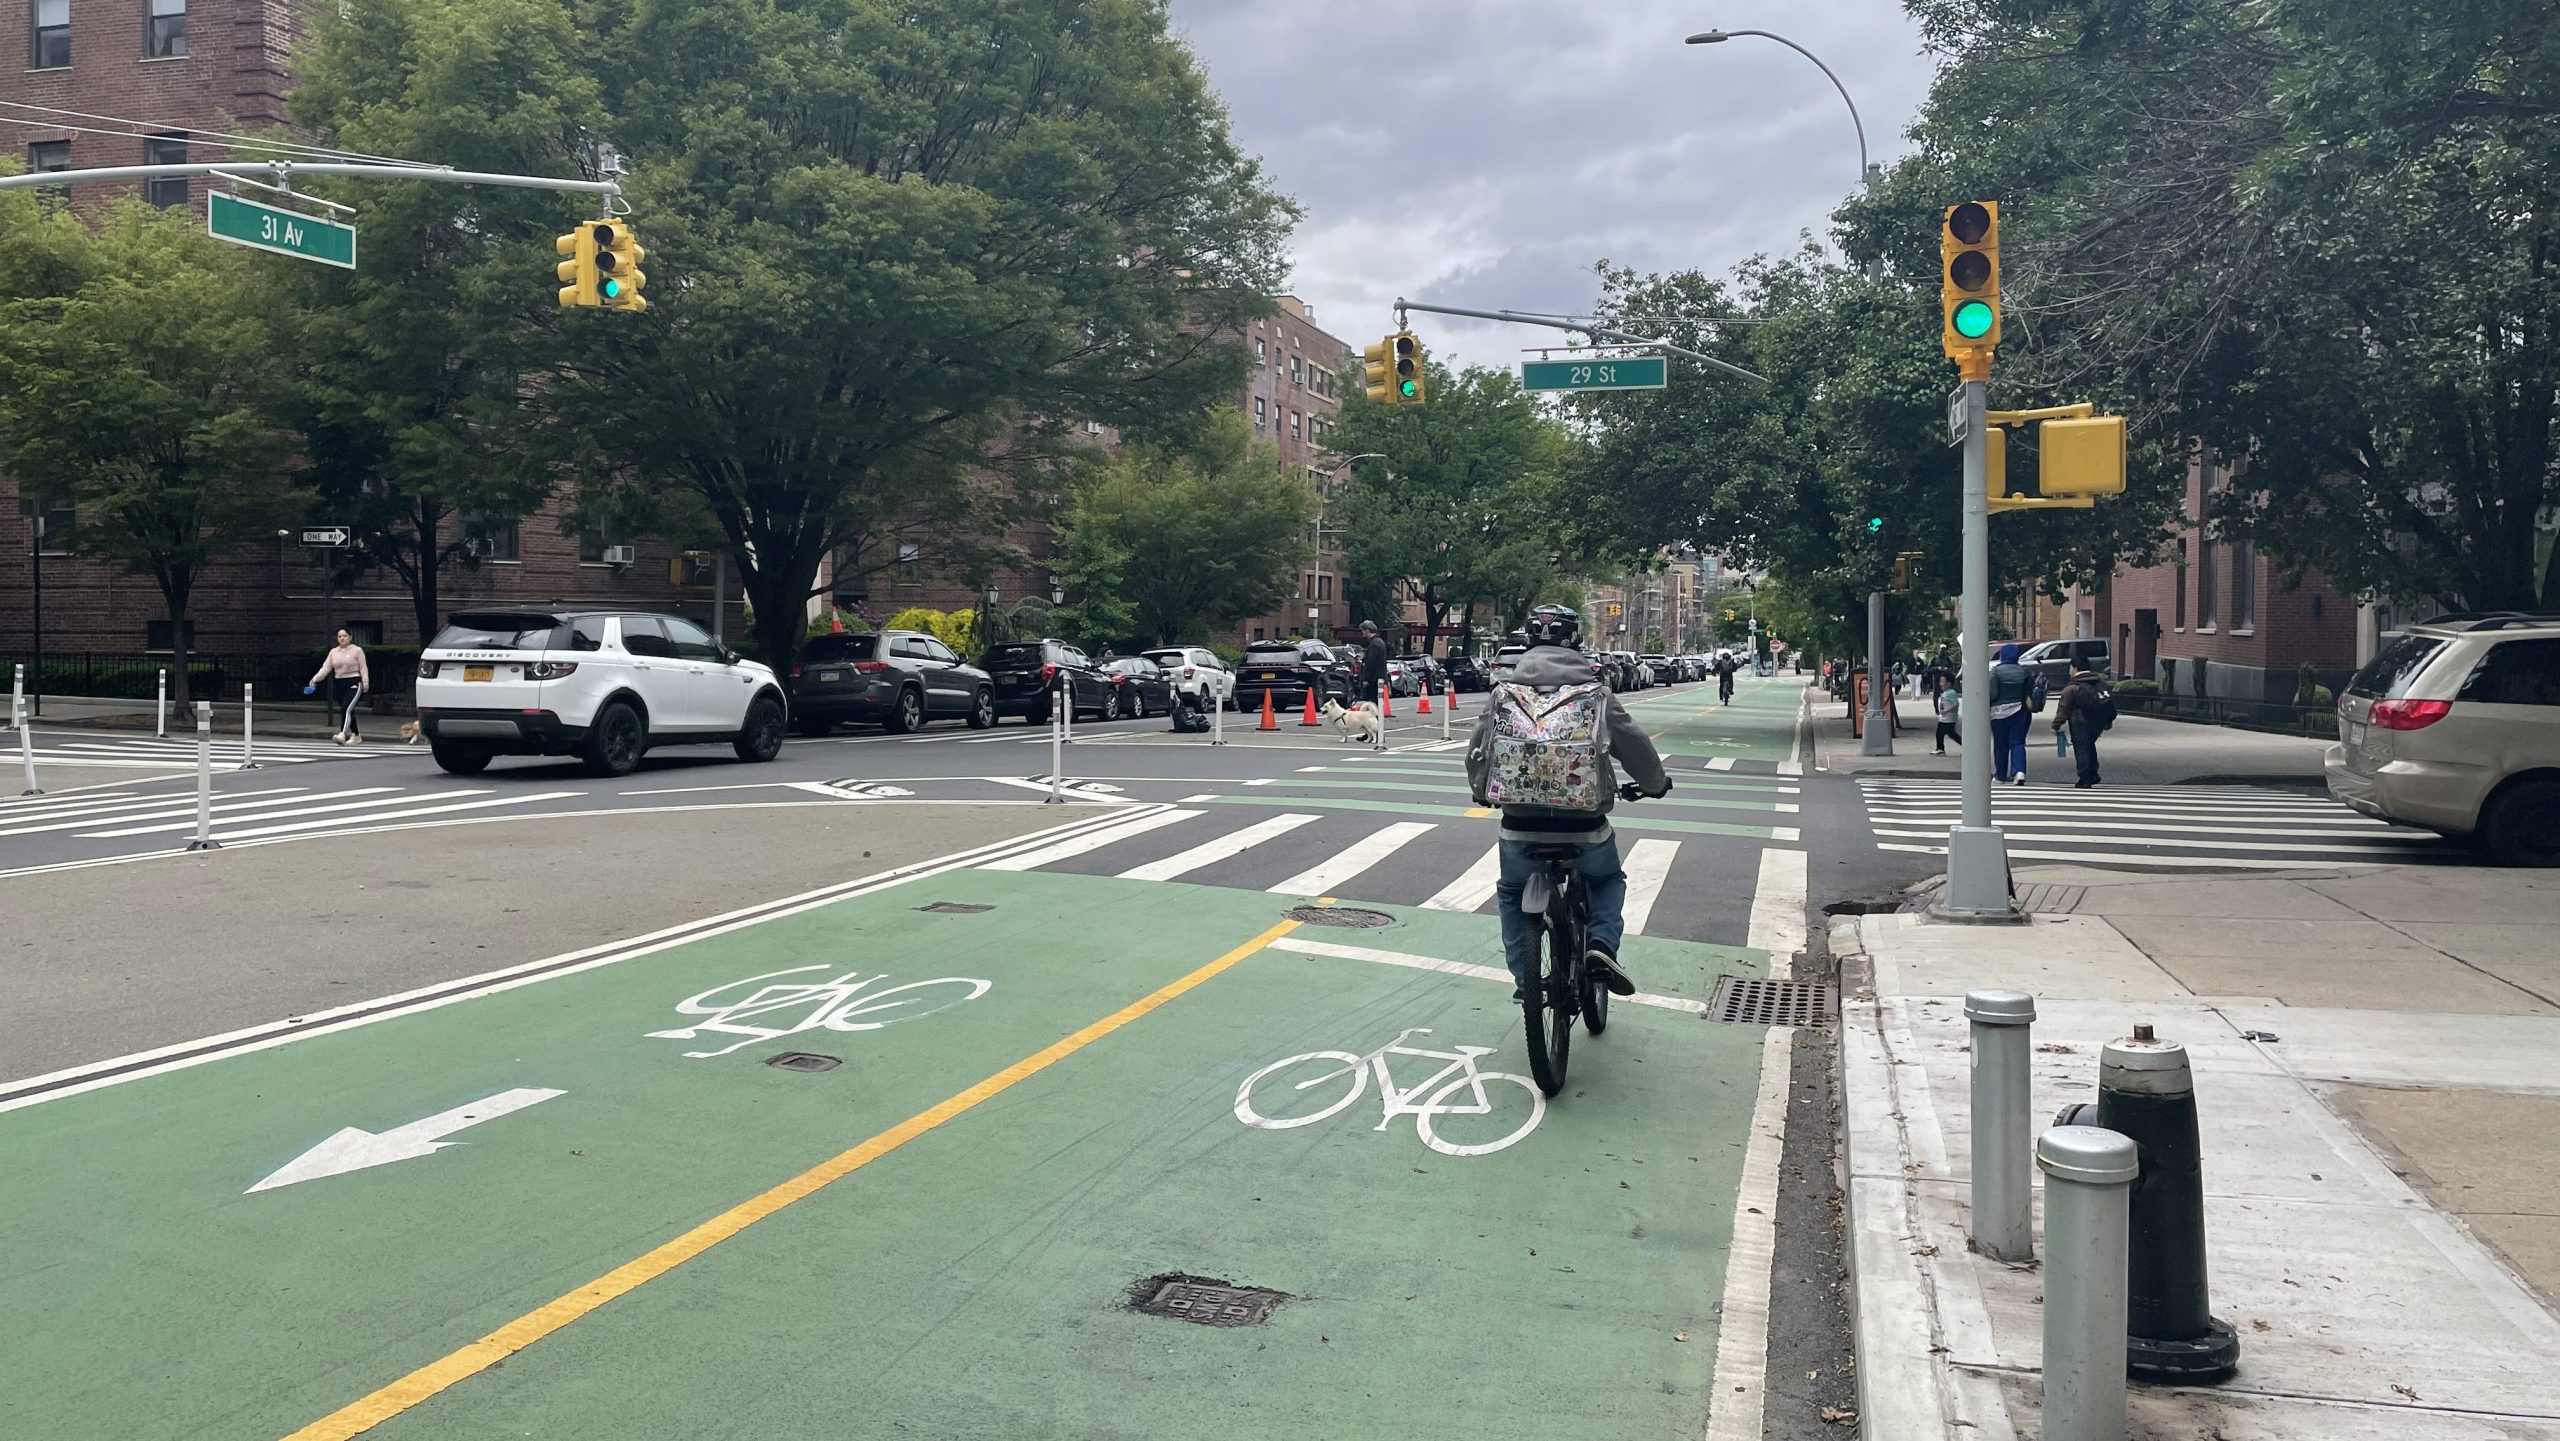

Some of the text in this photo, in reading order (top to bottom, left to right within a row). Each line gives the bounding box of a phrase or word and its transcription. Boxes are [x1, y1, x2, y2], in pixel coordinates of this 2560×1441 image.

[261, 215, 304, 248] 31 Av
[1570, 365, 1617, 384] 29 St
[307, 532, 343, 541] ONE WAY
